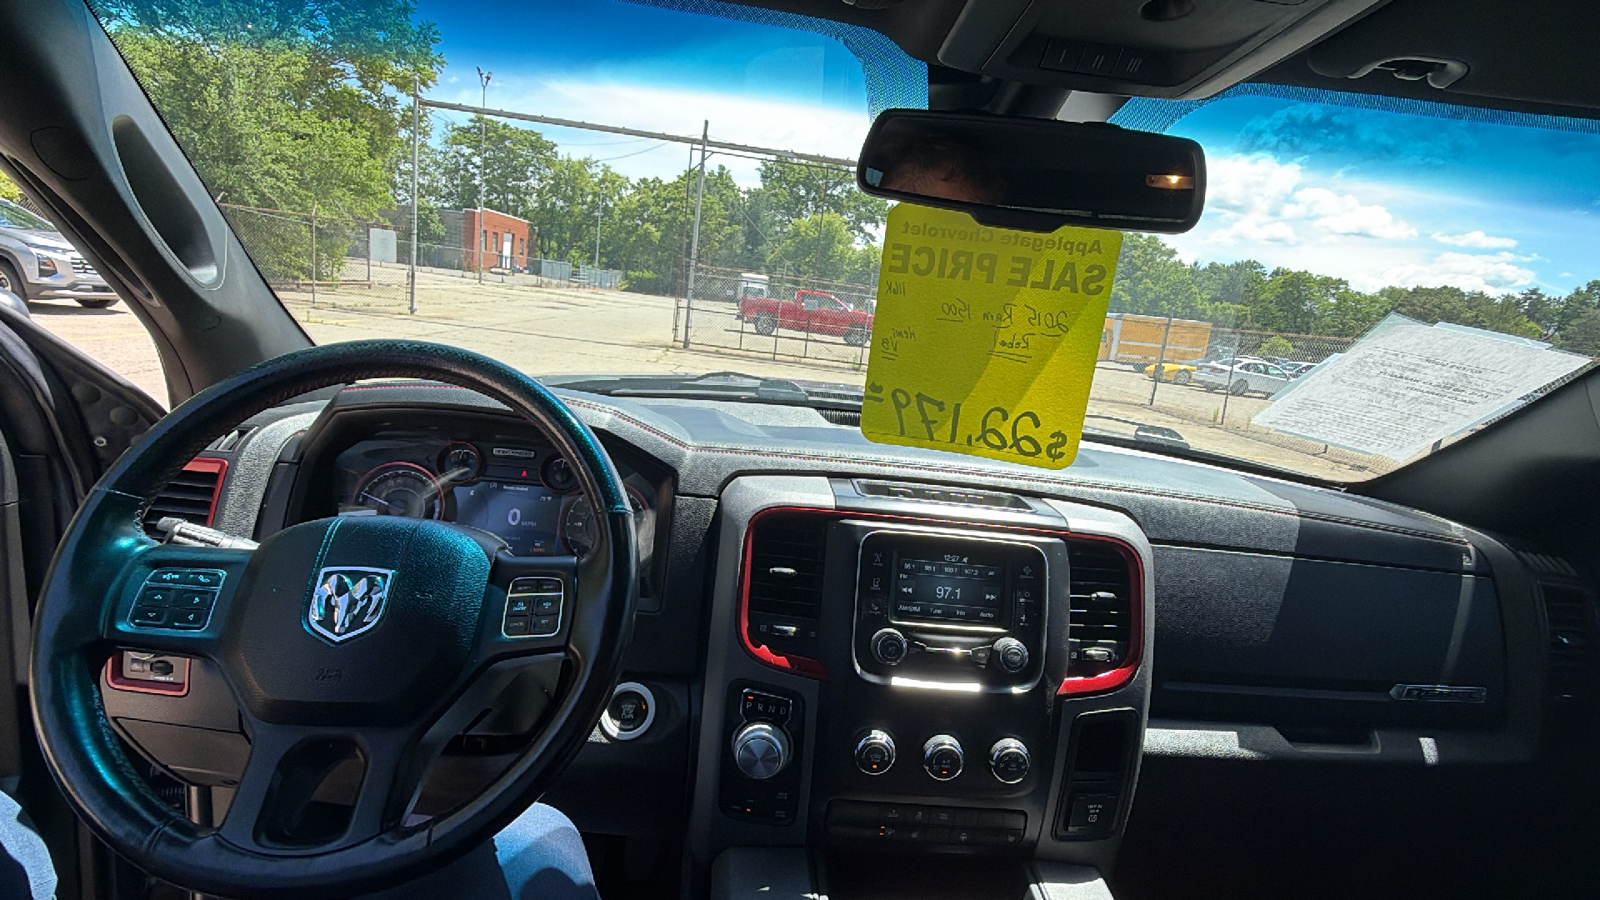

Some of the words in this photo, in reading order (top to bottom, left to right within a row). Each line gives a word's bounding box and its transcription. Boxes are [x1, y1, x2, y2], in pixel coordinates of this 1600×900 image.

[507, 508, 521, 526] 0
[936, 586, 961, 599] 97.1
[746, 701, 753, 709] P
[757, 703, 764, 711] R
[768, 705, 775, 713] N
[780, 706, 787, 715] D
